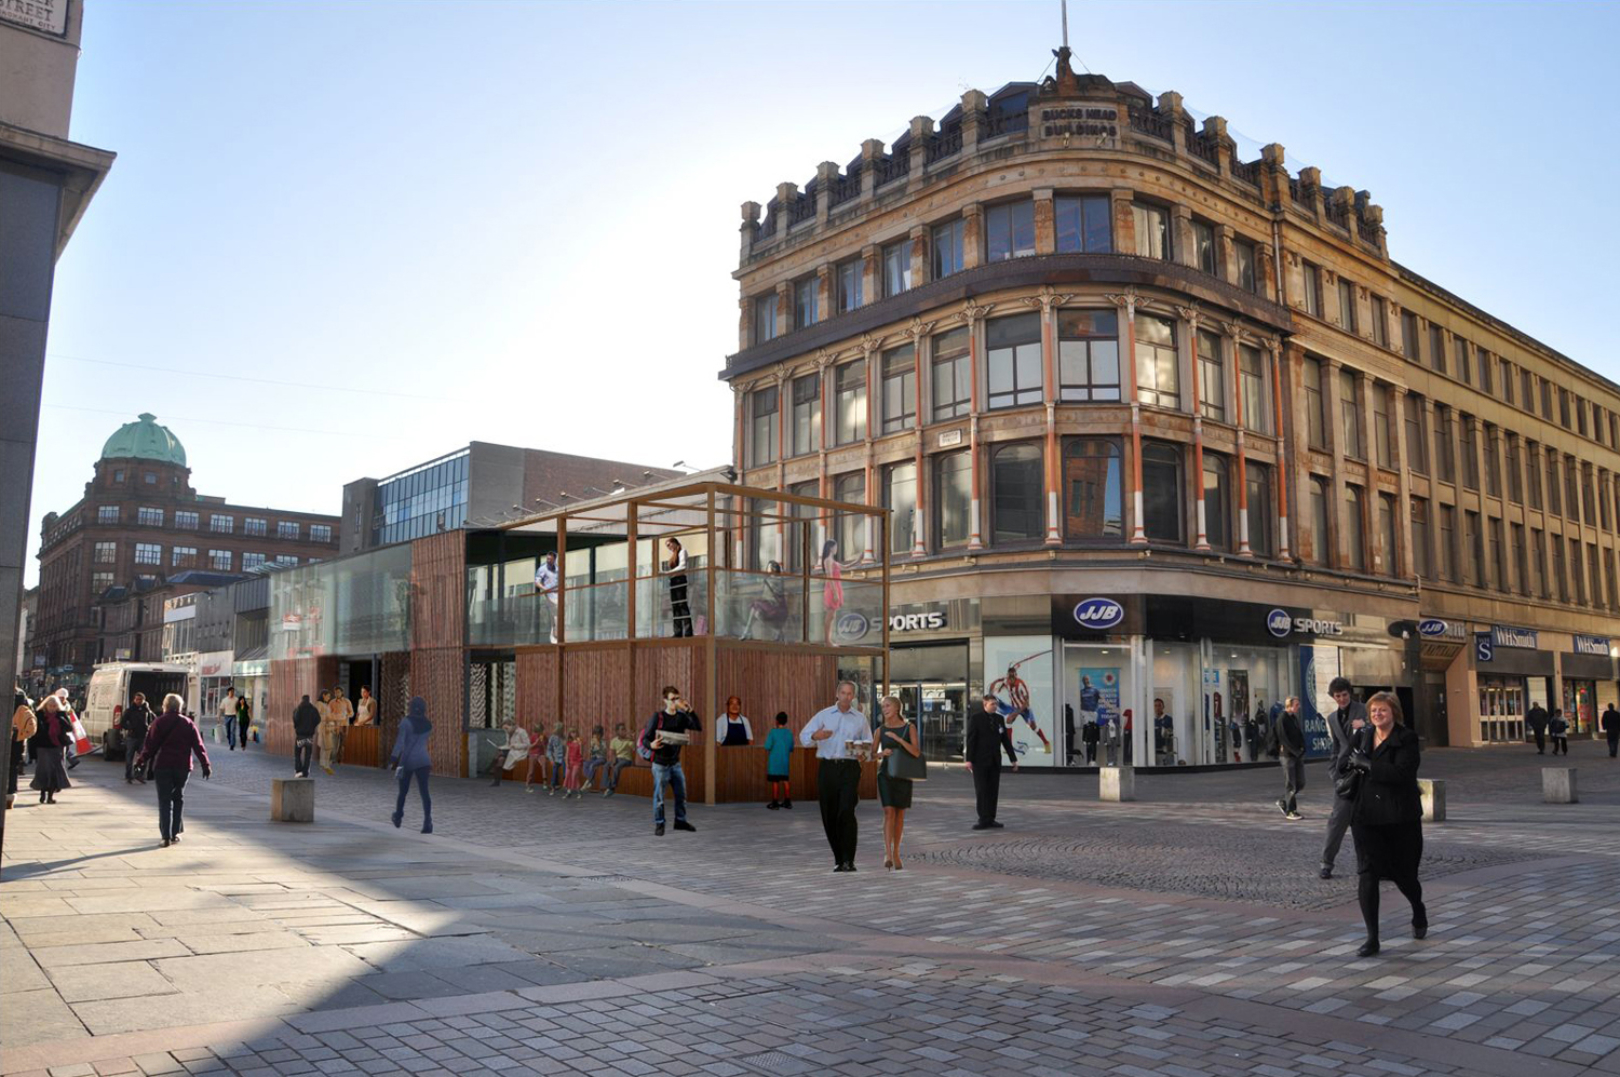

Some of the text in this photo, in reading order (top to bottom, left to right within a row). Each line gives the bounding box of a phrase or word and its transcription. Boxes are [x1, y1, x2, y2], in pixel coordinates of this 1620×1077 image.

[1079, 605, 1119, 620] JJB
[1271, 616, 1343, 635] JJB SPORTS
[1421, 623, 1443, 632] JJB
[1496, 625, 1535, 648] WHSmith
[1576, 635, 1608, 656] WHSmith
[1478, 642, 1492, 661] S
[1304, 719, 1326, 733] RANG
